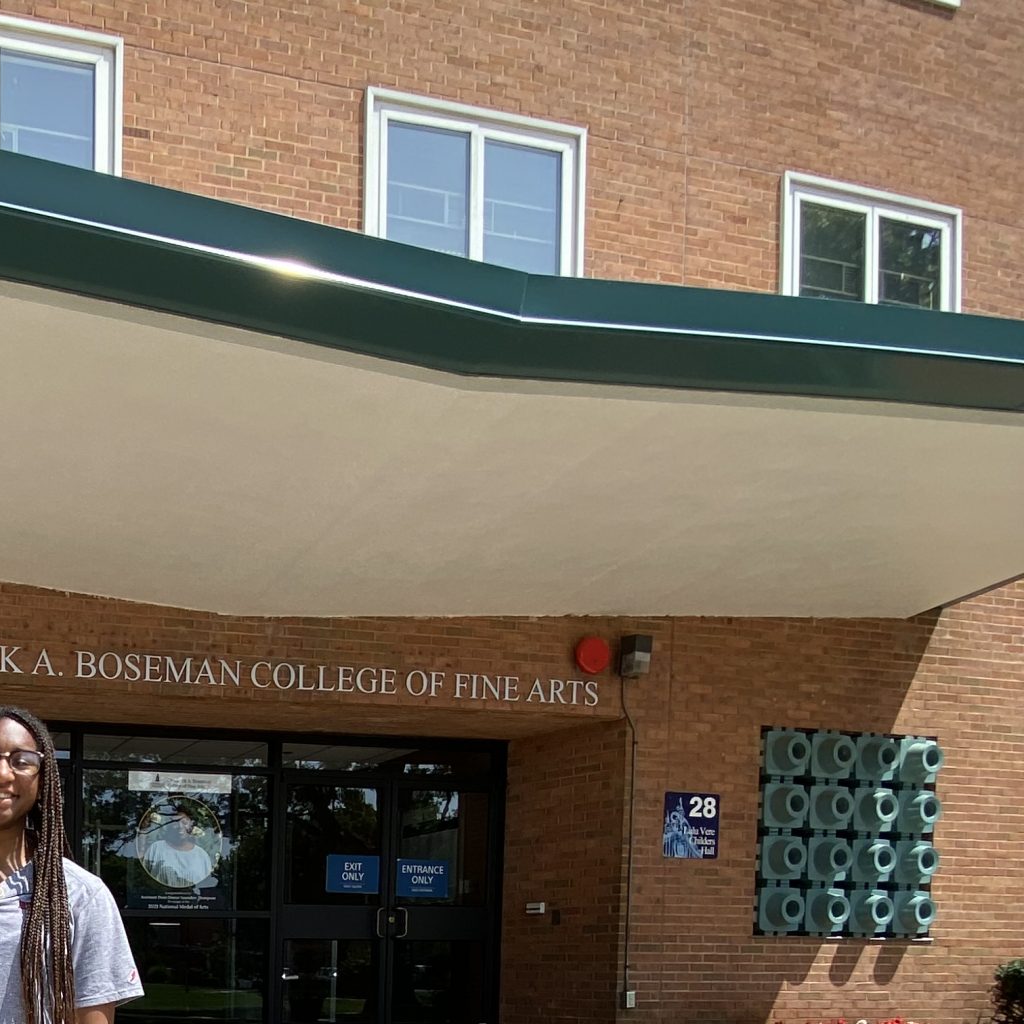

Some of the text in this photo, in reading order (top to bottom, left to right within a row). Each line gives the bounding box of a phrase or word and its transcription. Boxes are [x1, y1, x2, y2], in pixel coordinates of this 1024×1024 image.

[31, 648, 63, 677] A.
[74, 649, 242, 687] BOSEMAN
[250, 660, 397, 694] COLLEGE
[406, 669, 445, 698] OF
[454, 672, 520, 702] FINE
[526, 678, 599, 707] ARTS
[689, 796, 716, 818] 28
[344, 862, 363, 871] EXIT
[401, 864, 444, 874] ENTRANCE
[341, 872, 364, 881] ONLY
[411, 875, 434, 884] ONLY
